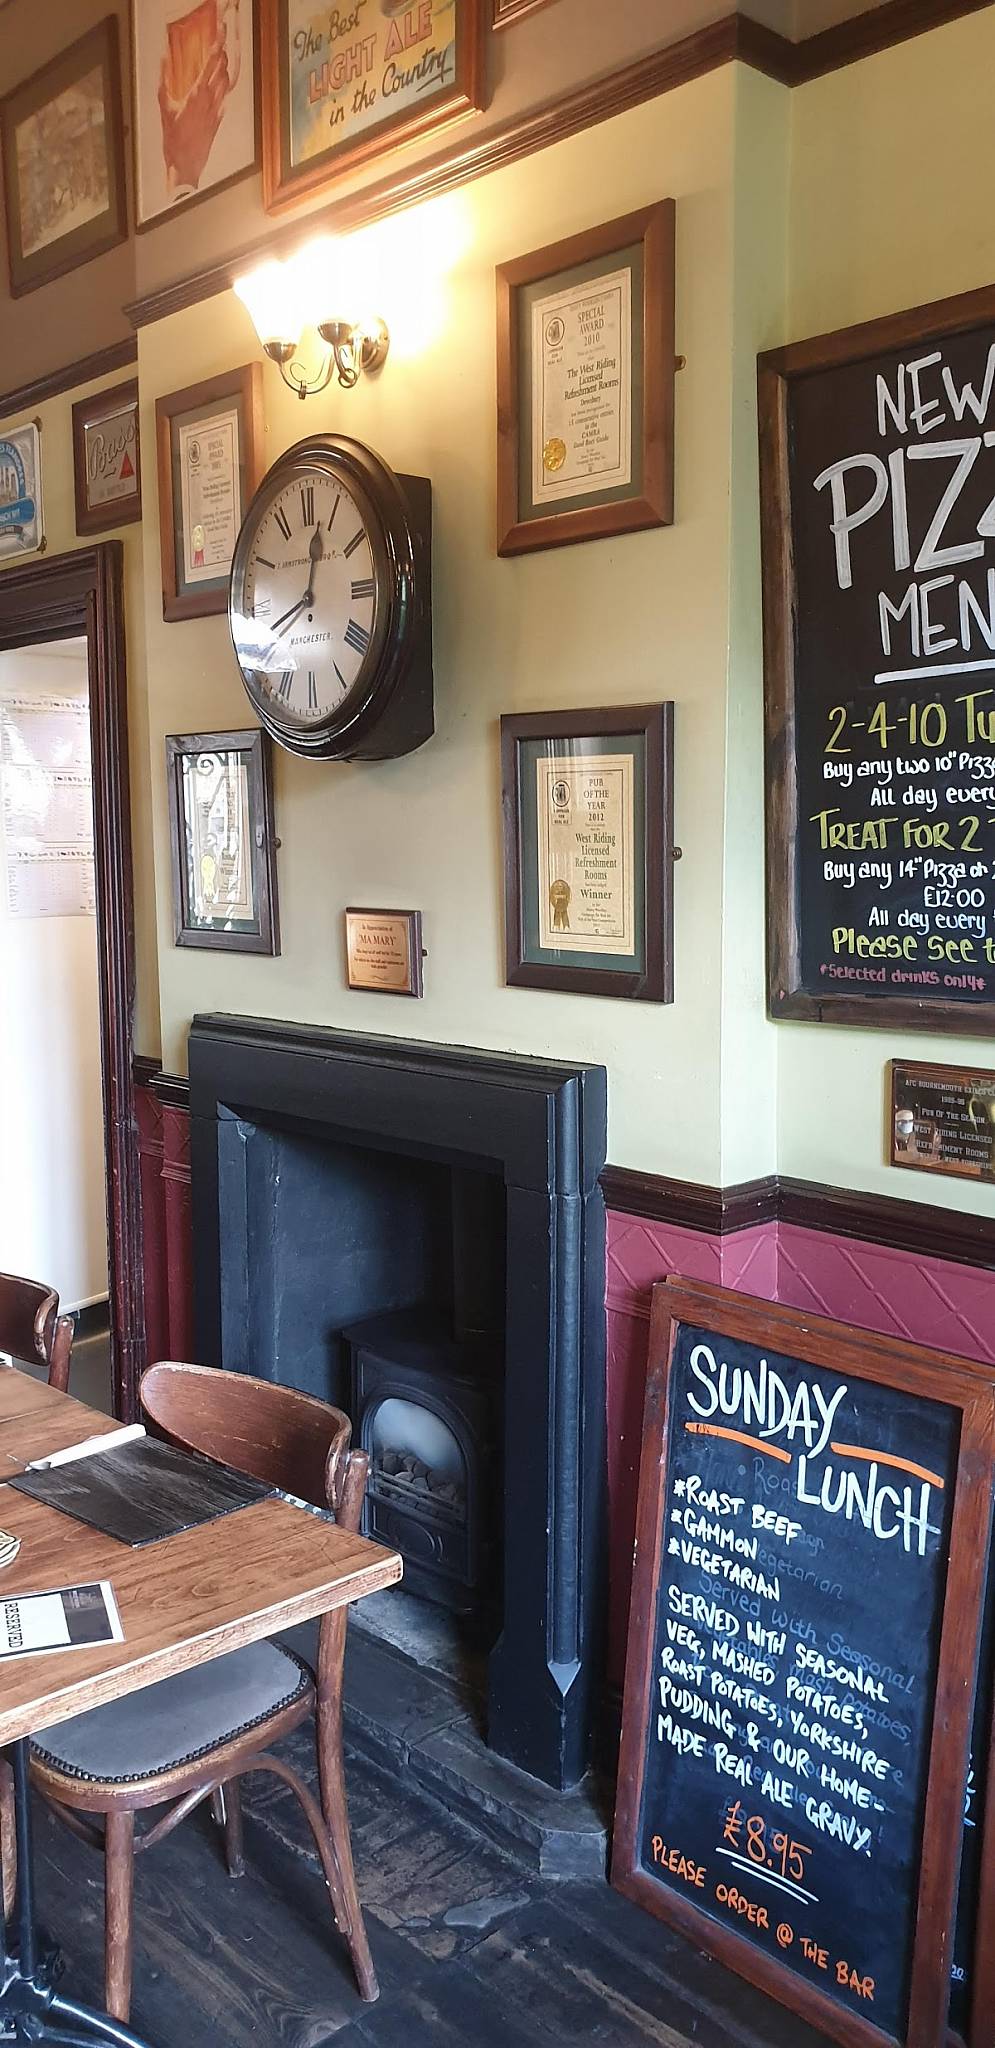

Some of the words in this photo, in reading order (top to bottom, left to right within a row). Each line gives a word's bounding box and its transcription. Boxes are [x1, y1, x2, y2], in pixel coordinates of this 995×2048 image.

[294, 26, 322, 62] The
[328, 0, 367, 43] Best
[309, 33, 378, 104] LIGHT
[384, 0, 433, 62] ALE
[330, 98, 345, 127] in
[351, 80, 377, 114] the
[382, 46, 452, 98] Country
[577, 305, 605, 323] SPECIAL
[580, 318, 605, 335] AWARD
[584, 332, 600, 346] 2010
[567, 369, 578, 379] The
[579, 364, 594, 375] West
[596, 357, 616, 369] Riding
[579, 370, 603, 386] Licensed
[598, 378, 619, 391] Rooms
[876, 342, 995, 436] NEW
[824, 701, 947, 754] 2-4-10
[589, 778, 604, 787] PUB
[823, 760, 854, 788] Buy
[856, 758, 893, 786] any
[896, 756, 930, 775] two
[958, 752, 995, 780] Pizz
[583, 790, 593, 798] OF
[594, 789, 609, 798] THE
[587, 801, 606, 810] YEAR
[870, 787, 896, 807] All
[902, 785, 938, 812] day
[588, 812, 604, 821] 2012
[809, 807, 899, 850] TREAT
[903, 818, 955, 851] FOR
[958, 816, 983, 852] 2
[575, 833, 591, 843] West
[593, 831, 616, 847] Riding
[581, 845, 610, 856] Licensed
[575, 856, 617, 868] Refreshment
[584, 869, 607, 880] Rooms
[823, 860, 855, 889] Buy
[858, 865, 892, 889] any
[924, 858, 966, 888] Pizza
[970, 862, 988, 878] or
[580, 889, 612, 900] Winner
[868, 907, 889, 927] All
[897, 909, 930, 935] day
[935, 912, 986, 939] every
[832, 927, 918, 961] Please
[891, 966, 940, 985] drinks
[905, 1079, 917, 1087] AFC
[685, 1344, 848, 1460] SUNDAY
[797, 1454, 941, 1556] LUNCH
[751, 1504, 802, 1546] BEEF
[4, 1602, 23, 1648] RESERVED
[668, 1584, 740, 1637] SERVED
[746, 1620, 788, 1656] WITH
[795, 1642, 890, 1704] SEASONAL
[712, 1639, 775, 1686] MASHED
[786, 1676, 869, 1740] POTATOES,
[658, 1675, 738, 1740] PUDDING
[746, 1721, 762, 1753] &
[772, 1738, 811, 1779] OUR
[660, 1646, 706, 1687] ROAST
[710, 1671, 784, 1729] POTATOES,
[790, 1709, 891, 1781] YORKSHIRE
[657, 1713, 707, 1758] MADE
[713, 1743, 753, 1787] REAL
[761, 1770, 794, 1809] ALE
[651, 1835, 707, 1888] PLEASE
[716, 1883, 770, 1929] ORDER
[776, 1923, 794, 1948] @
[799, 1937, 830, 1969] THE
[835, 1960, 875, 2001] BAR
